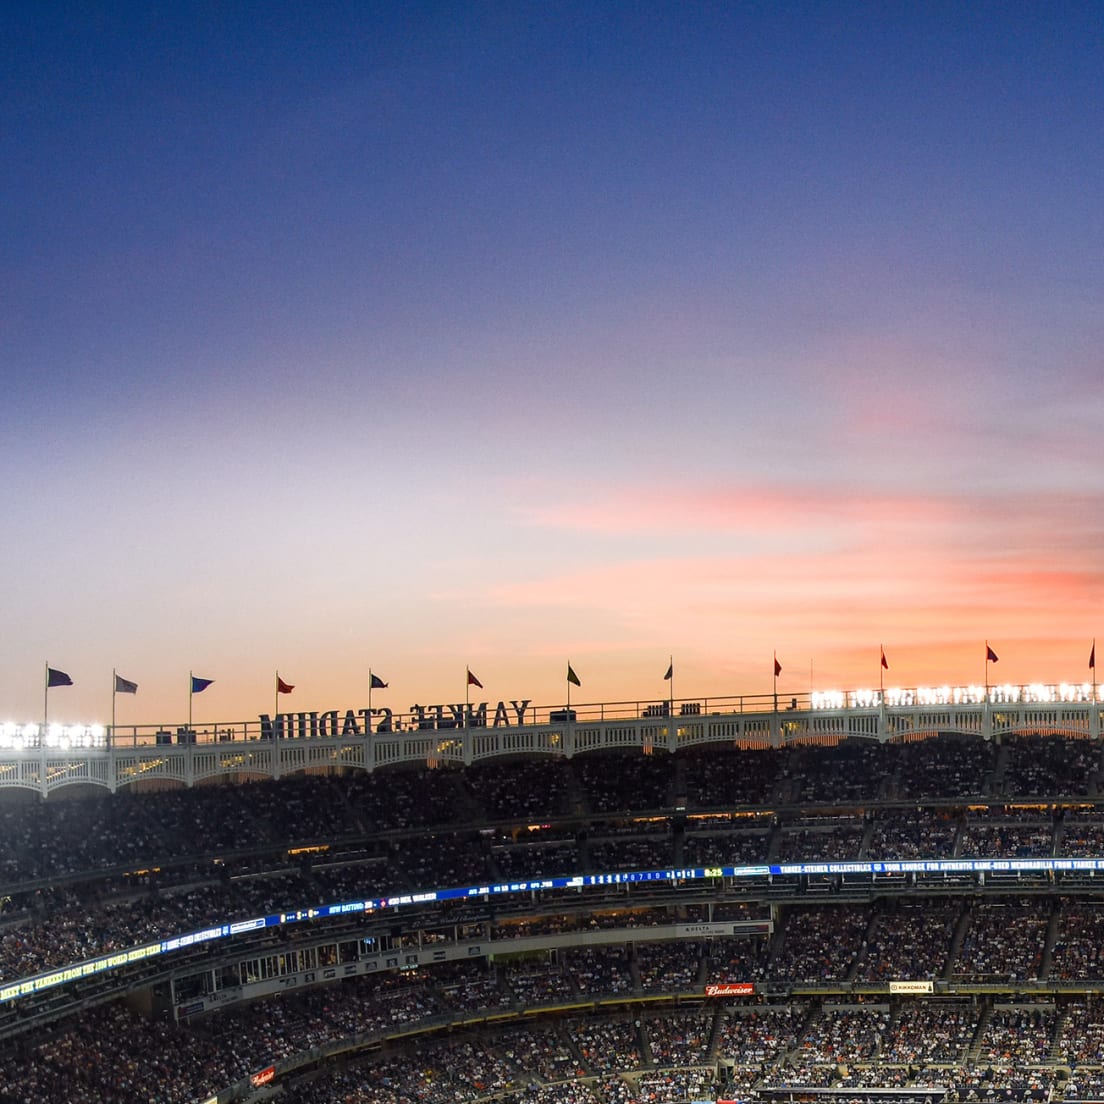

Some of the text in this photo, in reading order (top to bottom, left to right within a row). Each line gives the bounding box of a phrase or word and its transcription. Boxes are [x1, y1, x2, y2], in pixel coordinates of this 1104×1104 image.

[830, 864, 872, 873] COLLECTIBLES
[885, 863, 900, 872] YOUR
[901, 863, 926, 872] SOURCE
[926, 862, 940, 871] FOR
[940, 861, 973, 871] AUTHENTIC
[1054, 861, 1072, 870] FROM
[706, 984, 753, 996] Budweiser
